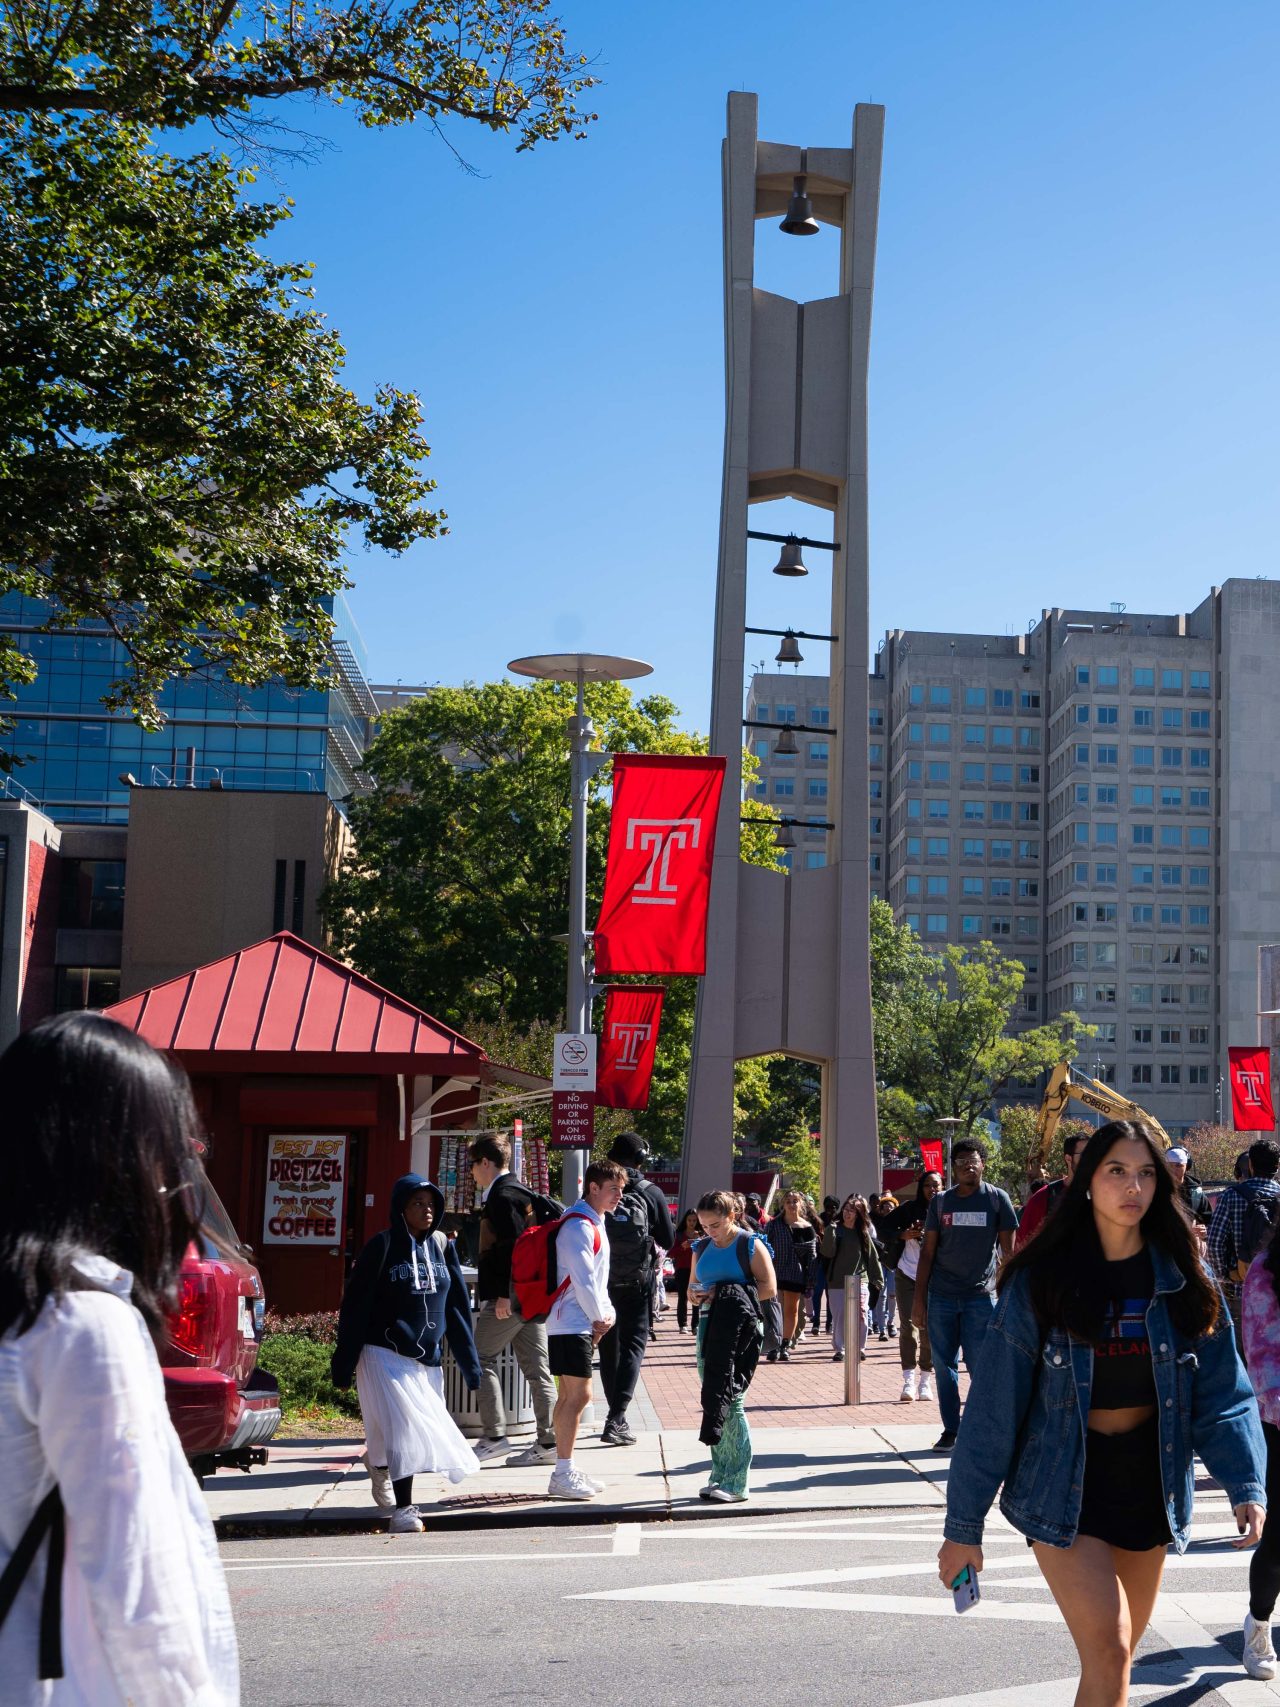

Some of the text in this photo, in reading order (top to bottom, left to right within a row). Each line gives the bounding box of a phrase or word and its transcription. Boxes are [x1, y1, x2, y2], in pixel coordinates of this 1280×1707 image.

[626, 818, 701, 905] T
[610, 1024, 651, 1070] T
[1236, 1071, 1264, 1106] T
[1081, 1093, 1110, 1113] KOBELCO
[273, 1140, 343, 1155] BEST HOT
[301, 1183, 309, 1191] &
[273, 1196, 298, 1204] Fresh
[268, 1216, 336, 1236] COFFEE
[390, 1262, 448, 1281] TORONT
[1096, 1342, 1149, 1358] CELAN
